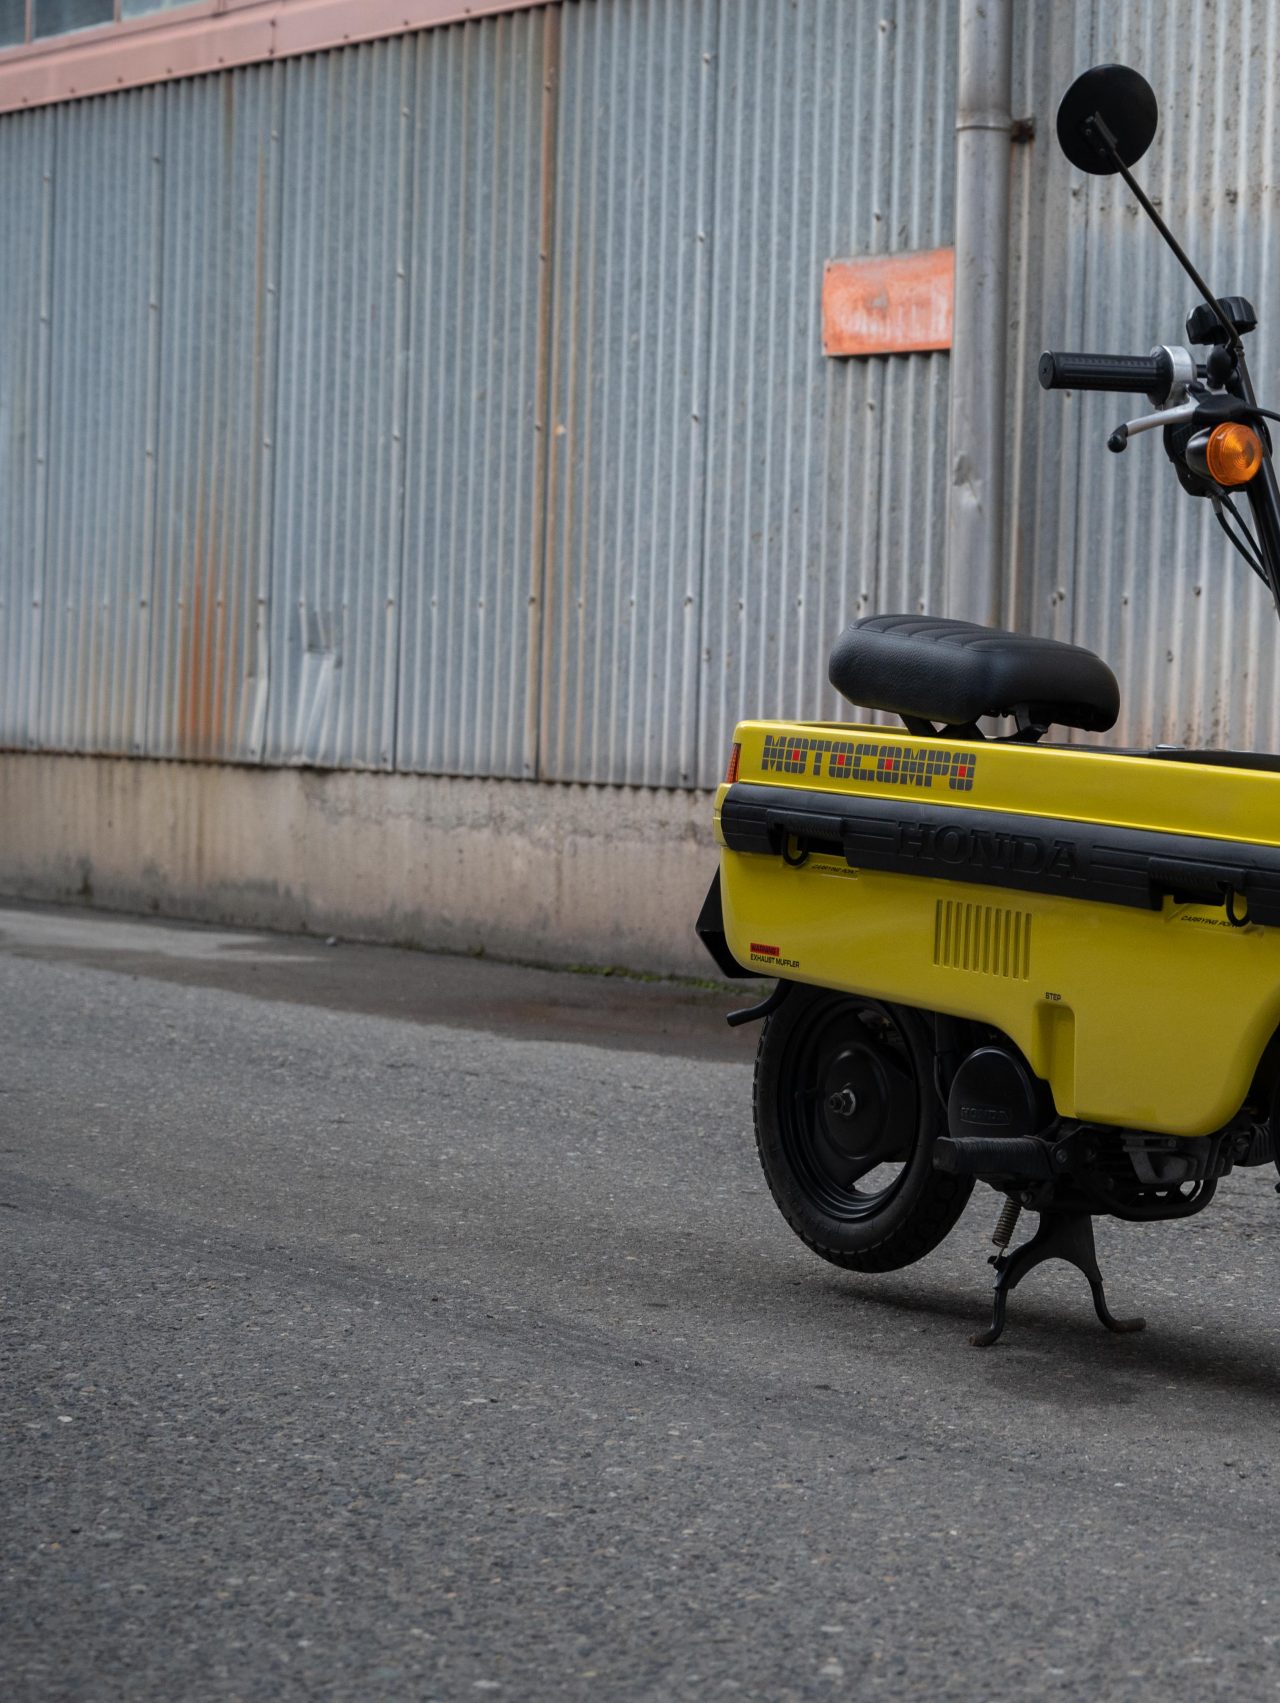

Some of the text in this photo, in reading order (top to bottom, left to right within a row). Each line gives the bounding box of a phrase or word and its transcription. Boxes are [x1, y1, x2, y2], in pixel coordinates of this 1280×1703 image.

[761, 735, 977, 792] MOTOCOMPO
[897, 820, 1088, 882] HONDA
[751, 953, 799, 968] EXHAUST MUFFLER
[1045, 991, 1062, 1001] STEP
